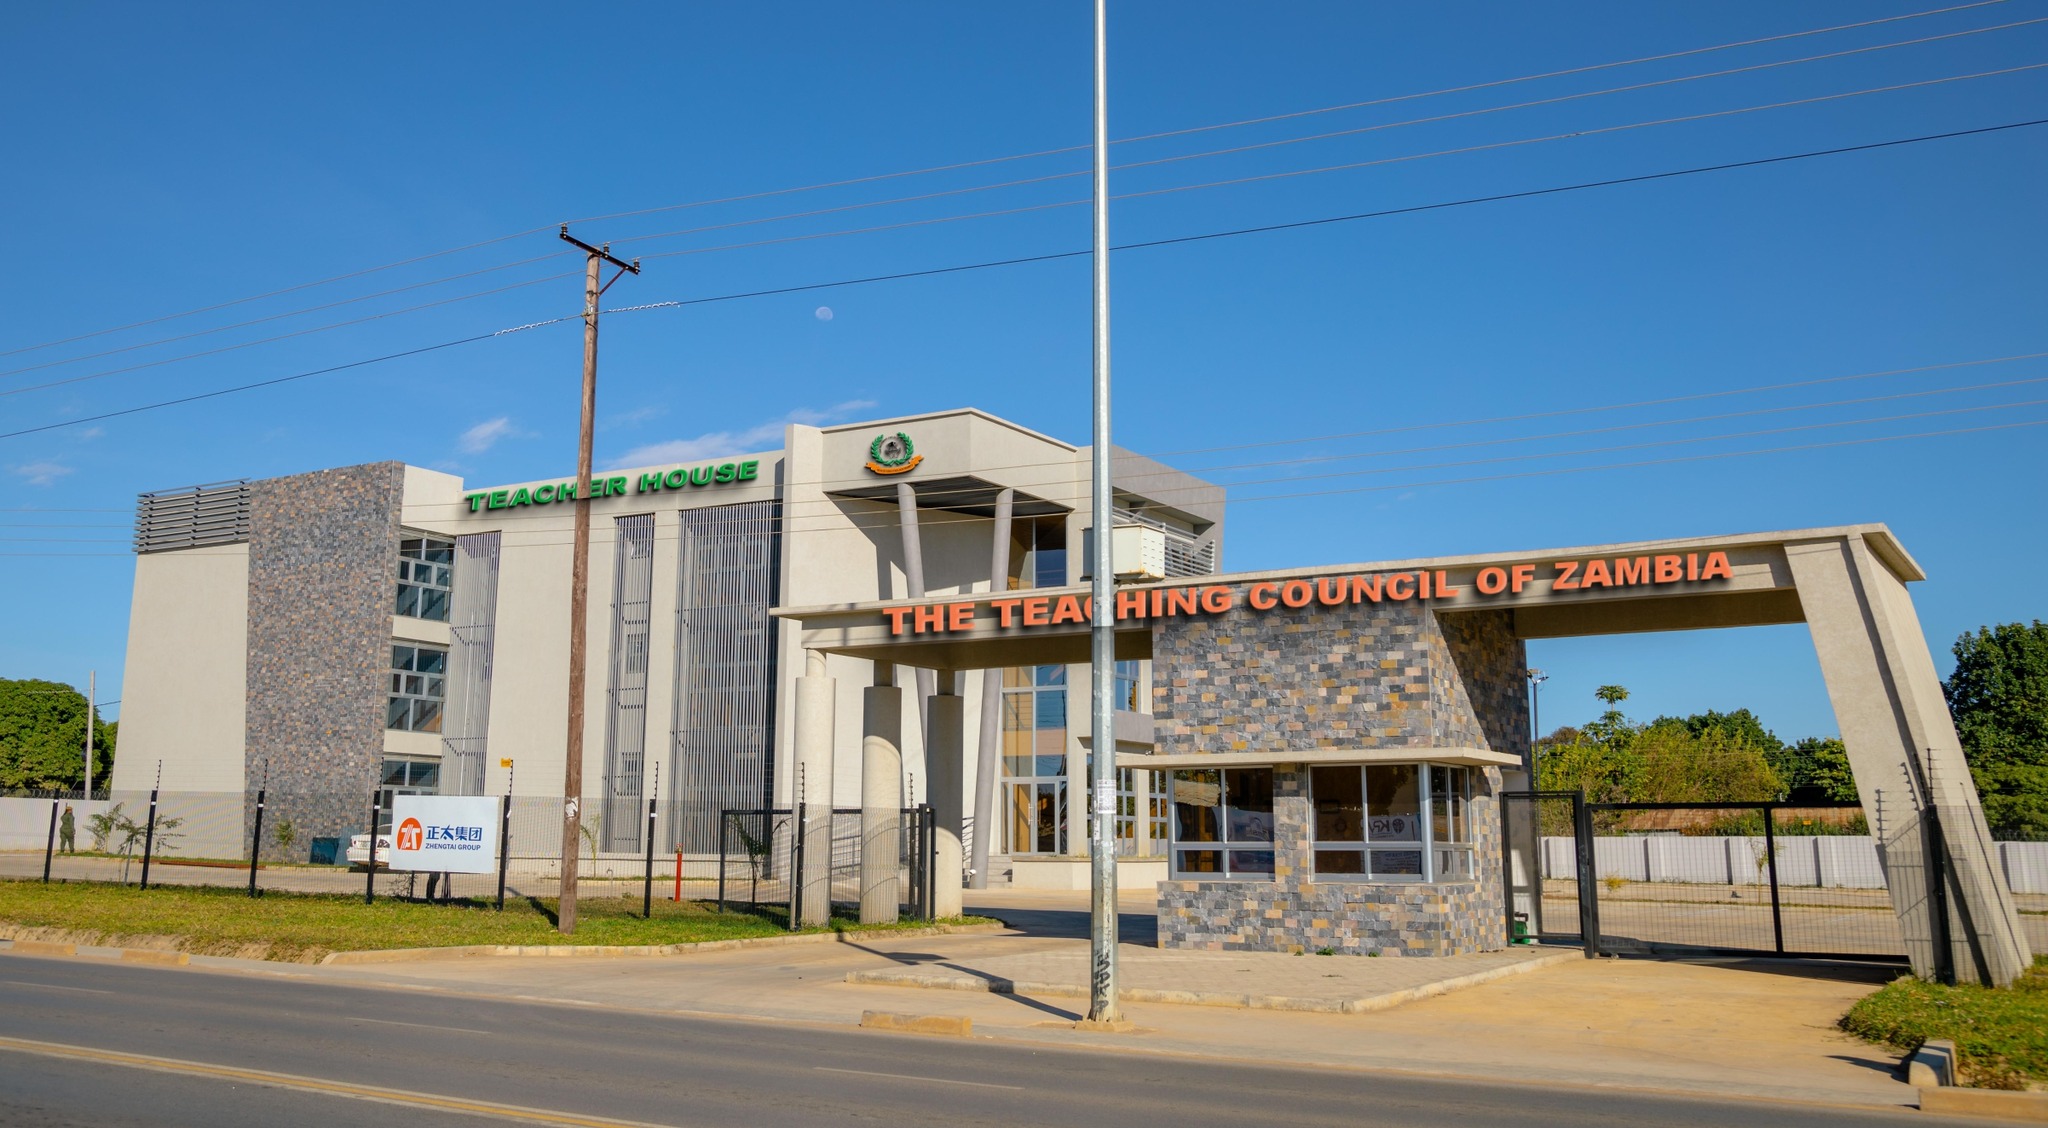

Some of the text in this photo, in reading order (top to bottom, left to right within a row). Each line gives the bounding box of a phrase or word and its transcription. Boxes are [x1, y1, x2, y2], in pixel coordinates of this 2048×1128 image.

[465, 460, 759, 511] TEACHER HOUSE
[882, 602, 976, 635] THE
[1249, 570, 1459, 610] COUNCIL
[1476, 564, 1536, 595] OF
[1553, 551, 1735, 590] ZAMBIA
[426, 824, 482, 841] 正太集团
